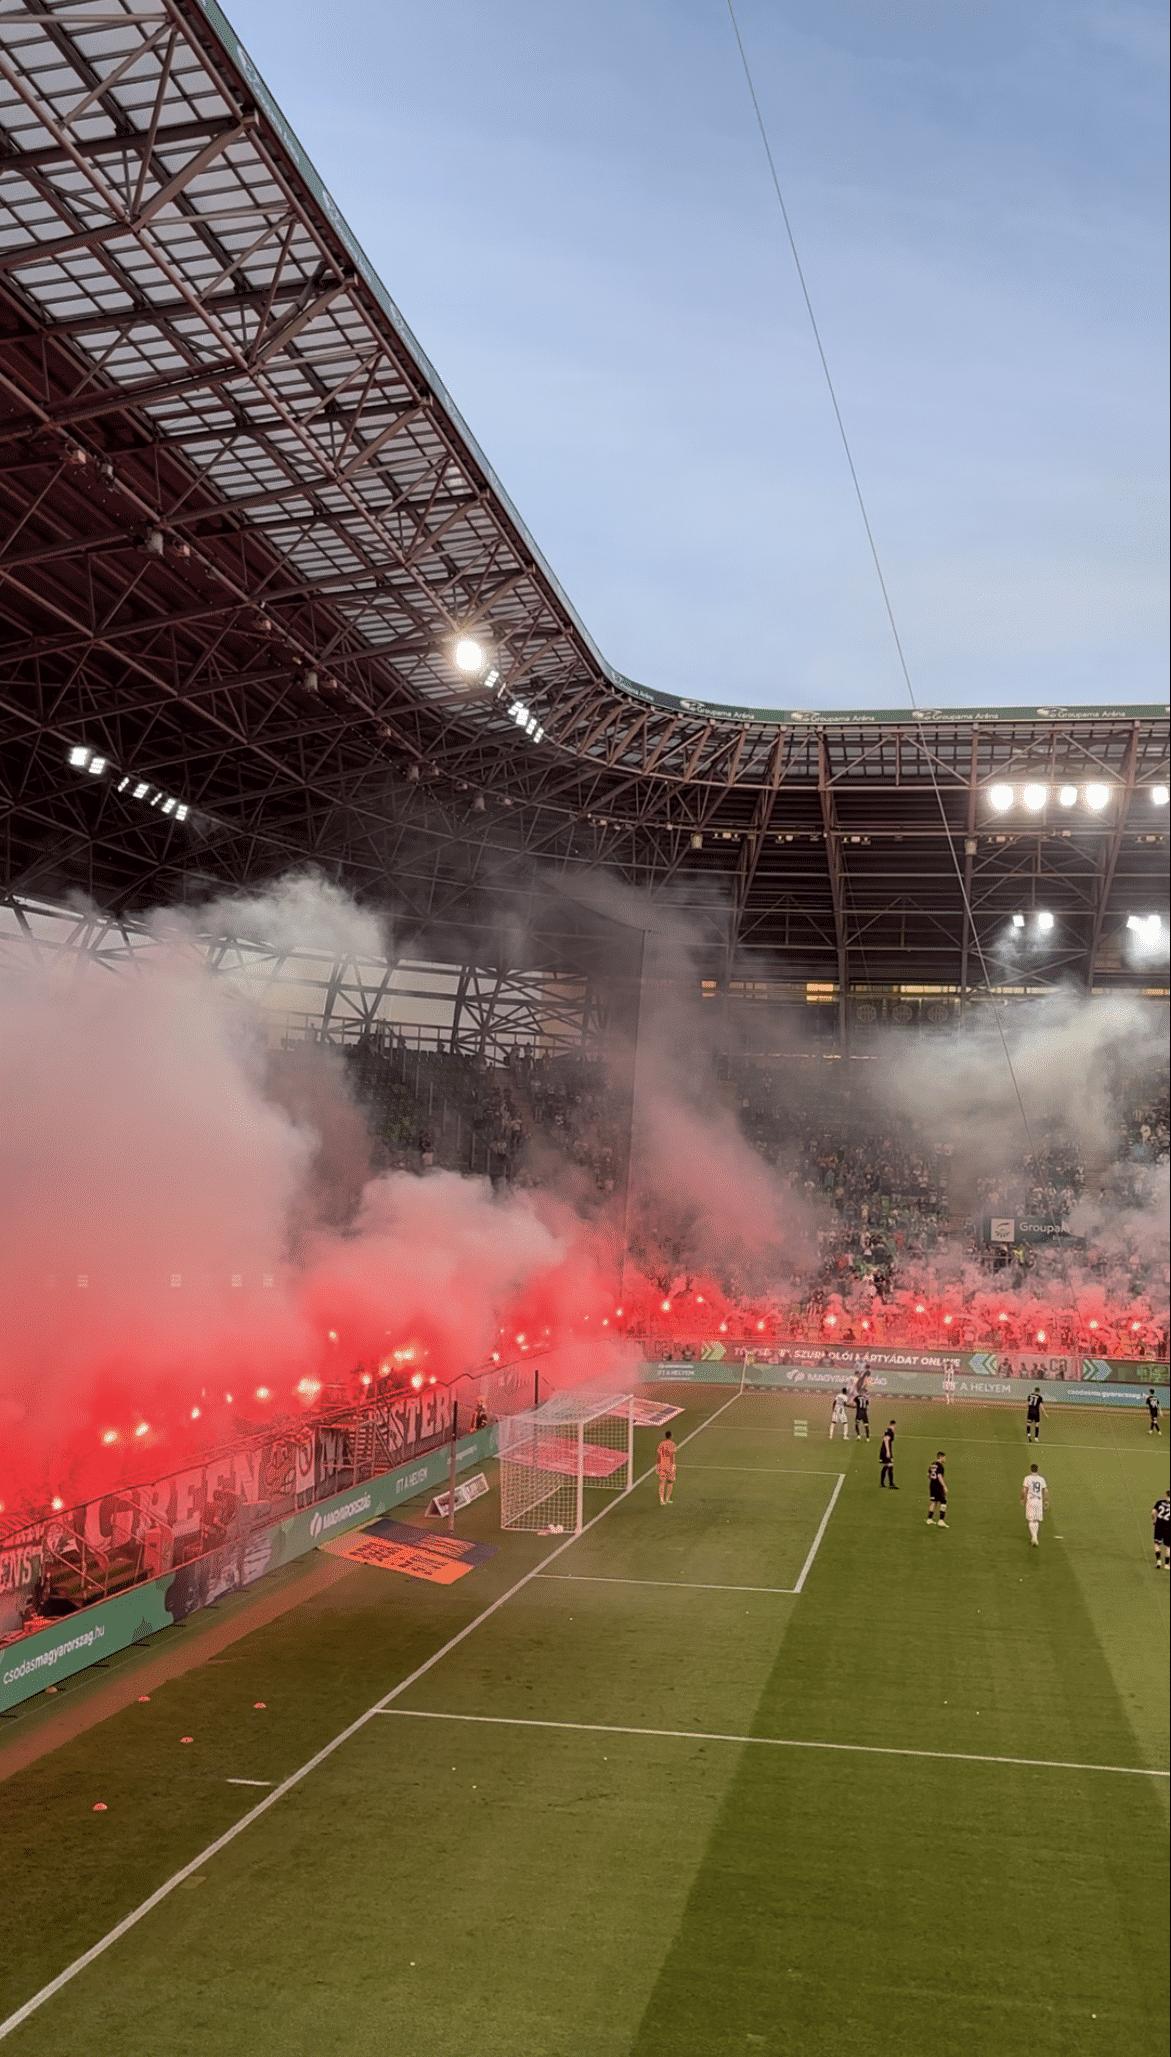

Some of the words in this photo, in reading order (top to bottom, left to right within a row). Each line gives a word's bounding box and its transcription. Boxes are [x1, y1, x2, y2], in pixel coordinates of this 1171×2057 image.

[932, 713, 973, 721] Groupama
[1057, 711, 1099, 719] Groupama
[807, 1373, 887, 1386] MAGYARZÁG
[970, 1382, 1011, 1393] HELYEM
[1032, 1481, 1041, 1493] 19
[1157, 1505, 1170, 1521] 22
